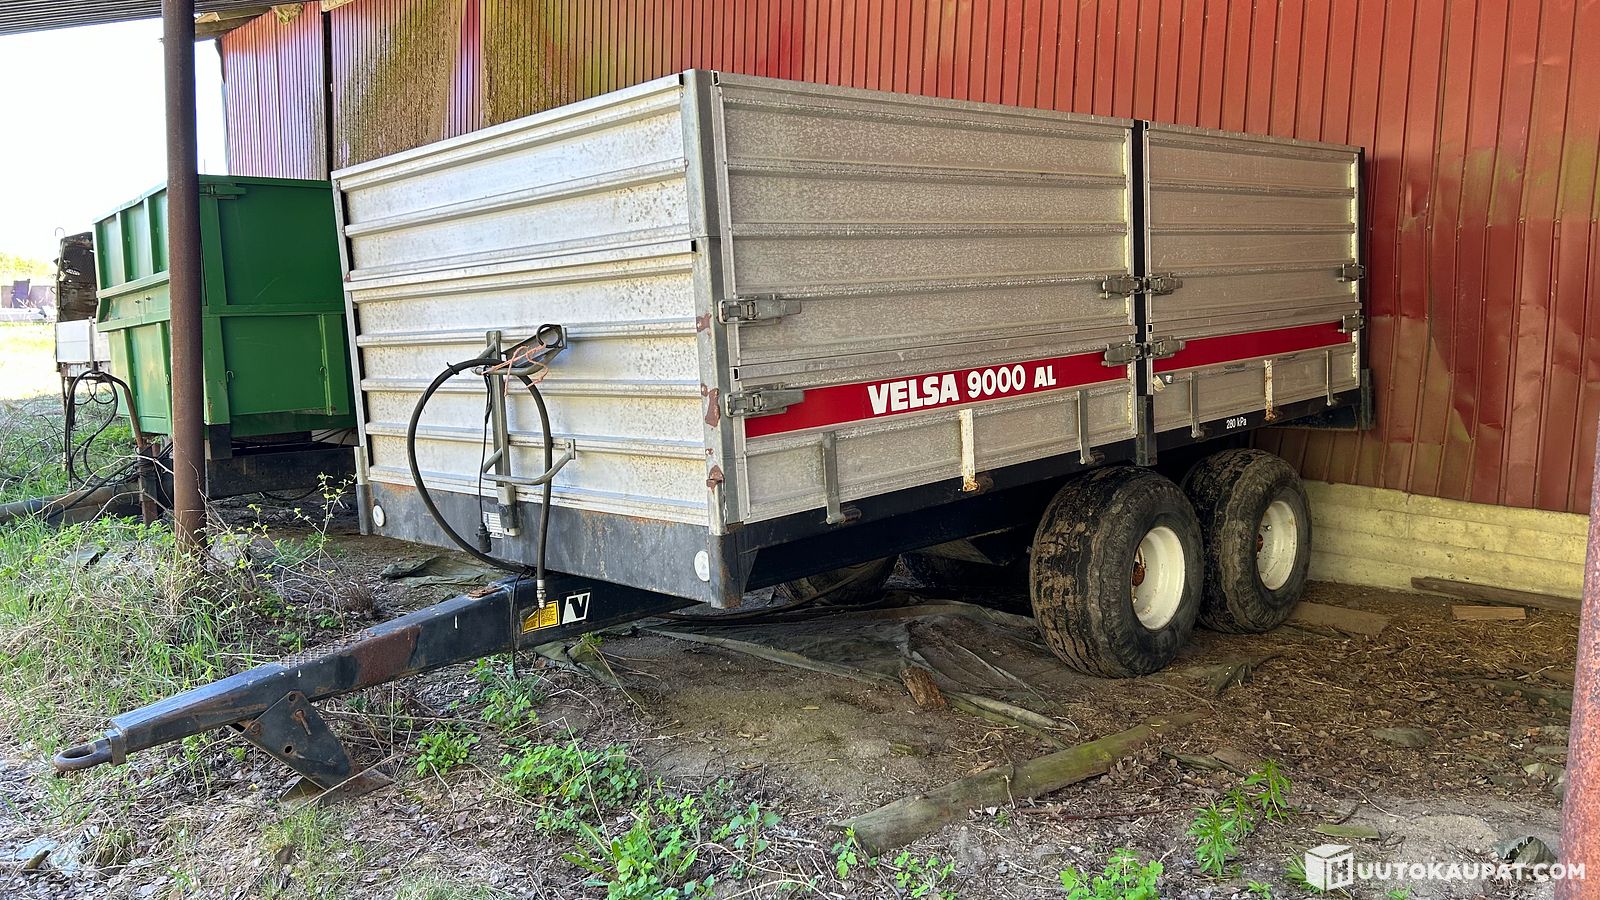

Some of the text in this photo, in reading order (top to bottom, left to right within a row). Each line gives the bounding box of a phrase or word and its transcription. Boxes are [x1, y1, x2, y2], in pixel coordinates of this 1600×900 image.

[867, 364, 1057, 415] VELSA 9000 AL
[1236, 416, 1247, 427] kPa
